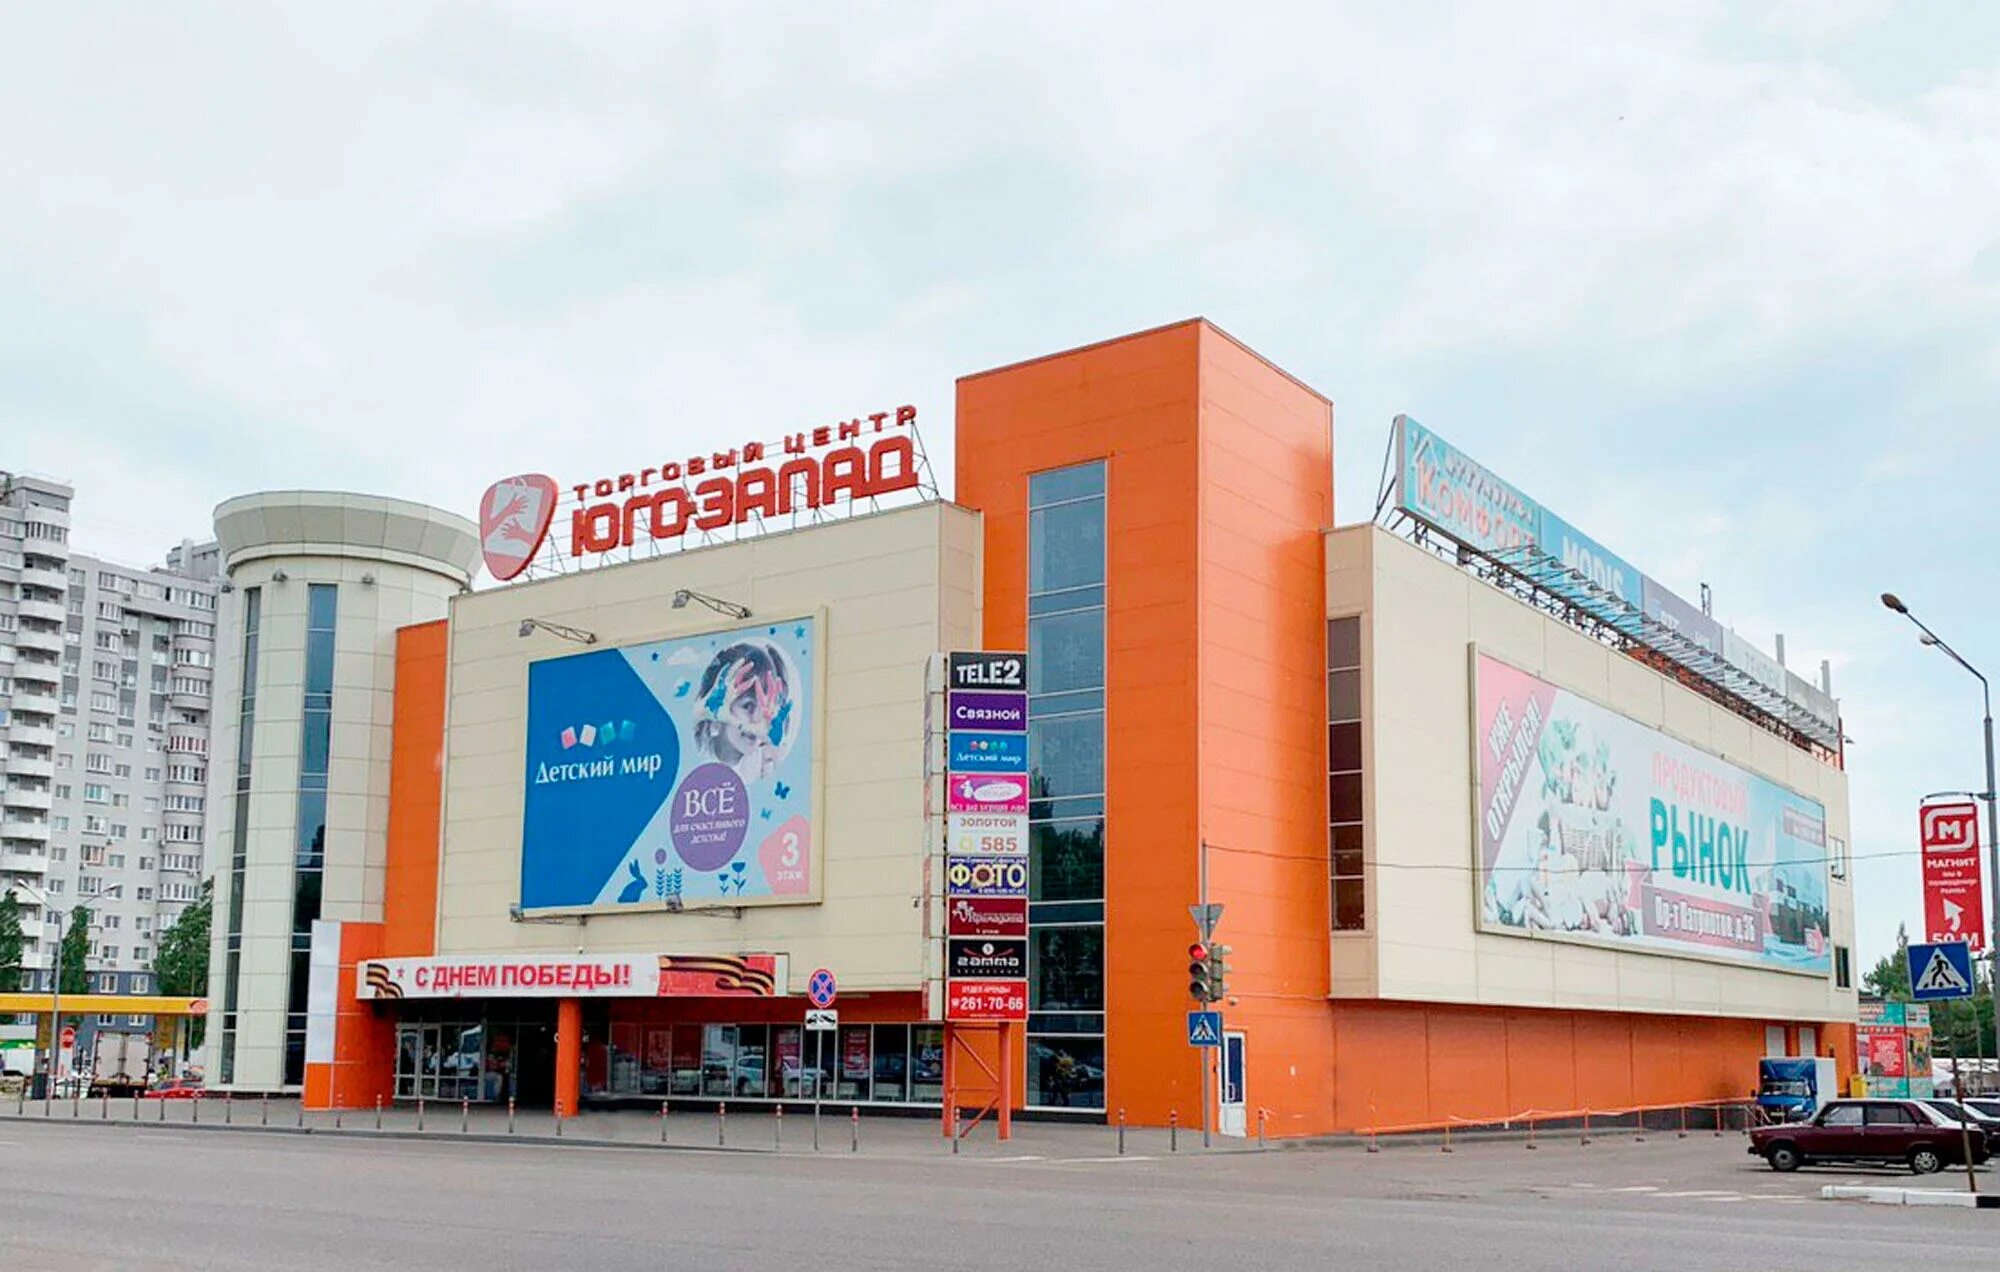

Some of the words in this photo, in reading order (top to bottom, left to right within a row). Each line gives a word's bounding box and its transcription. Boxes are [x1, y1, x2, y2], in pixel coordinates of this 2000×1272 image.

[573, 441, 764, 502] ТОРГОВЫЙ
[784, 404, 918, 455] ЦЕНТР
[571, 435, 919, 557] ЮГО-ЗАПАД
[1562, 534, 1624, 601] MODIS
[956, 659, 1021, 685] TELE2
[535, 755, 615, 785] Детский
[619, 753, 662, 780] мир
[956, 752, 998, 763] Детский
[1000, 755, 1022, 765] мир
[683, 781, 737, 818] ВСЁ
[960, 817, 1018, 828] ЗОЛОТОЙ
[781, 831, 800, 868] 3
[980, 836, 1018, 852] 585
[1650, 797, 1751, 896] РЫНОК
[949, 862, 1026, 889] ФОТО
[1926, 857, 1978, 869] МАГНИТ
[415, 968, 429, 988] С
[432, 966, 497, 988] ДНЕМ
[501, 963, 630, 987] ПОБЕДЫ!
[960, 996, 1025, 1011] 261-70-66
